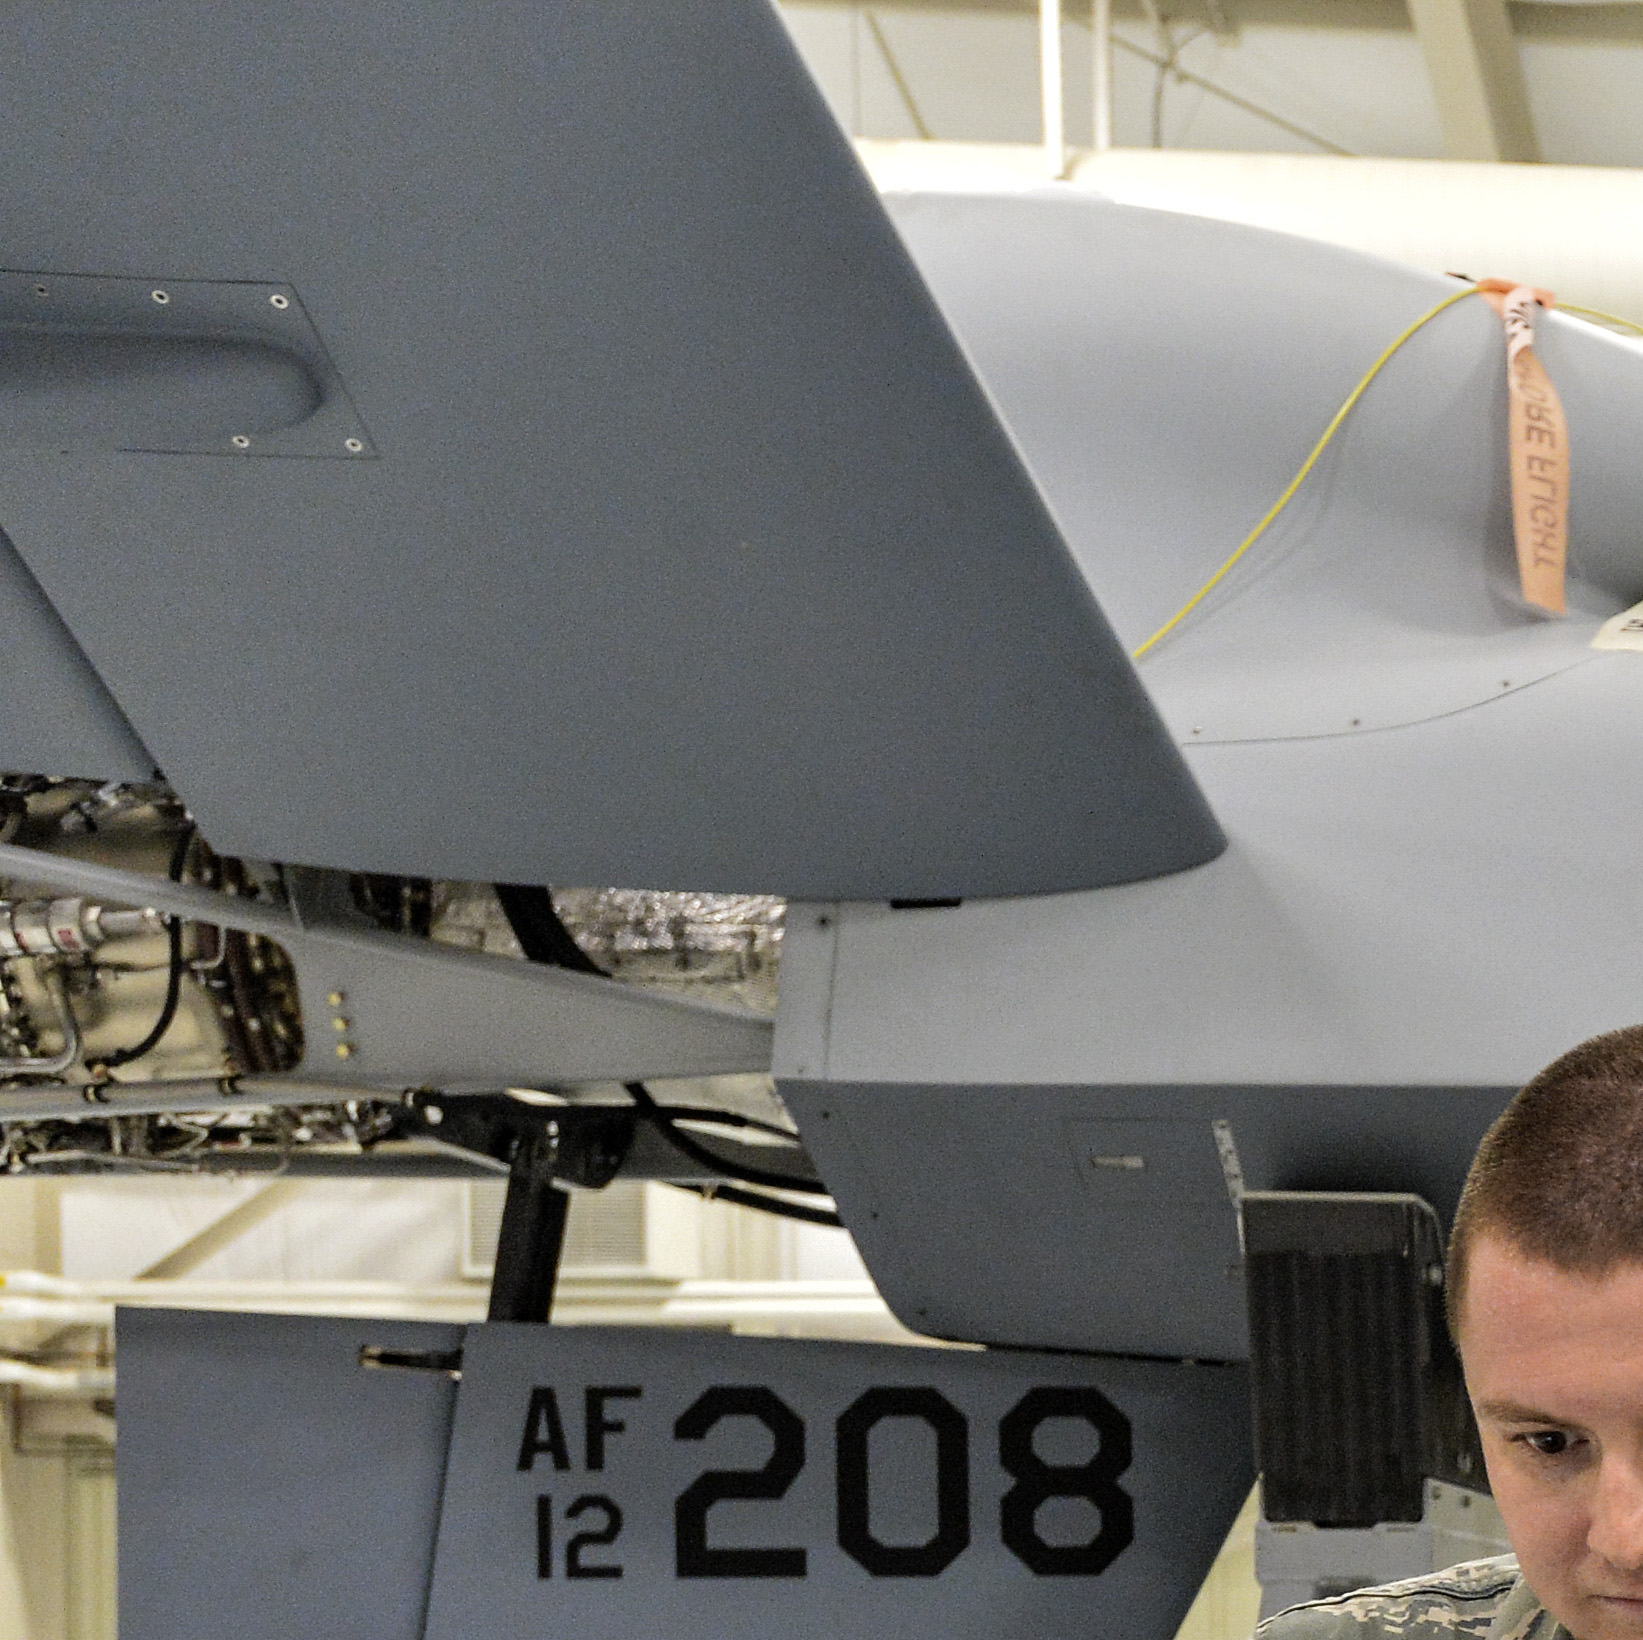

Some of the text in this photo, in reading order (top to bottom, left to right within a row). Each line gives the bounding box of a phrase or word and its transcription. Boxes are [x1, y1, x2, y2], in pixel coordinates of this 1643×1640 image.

[516, 1386, 642, 1472] AF
[673, 1385, 1136, 1578] 208
[536, 1494, 624, 1580] 12
